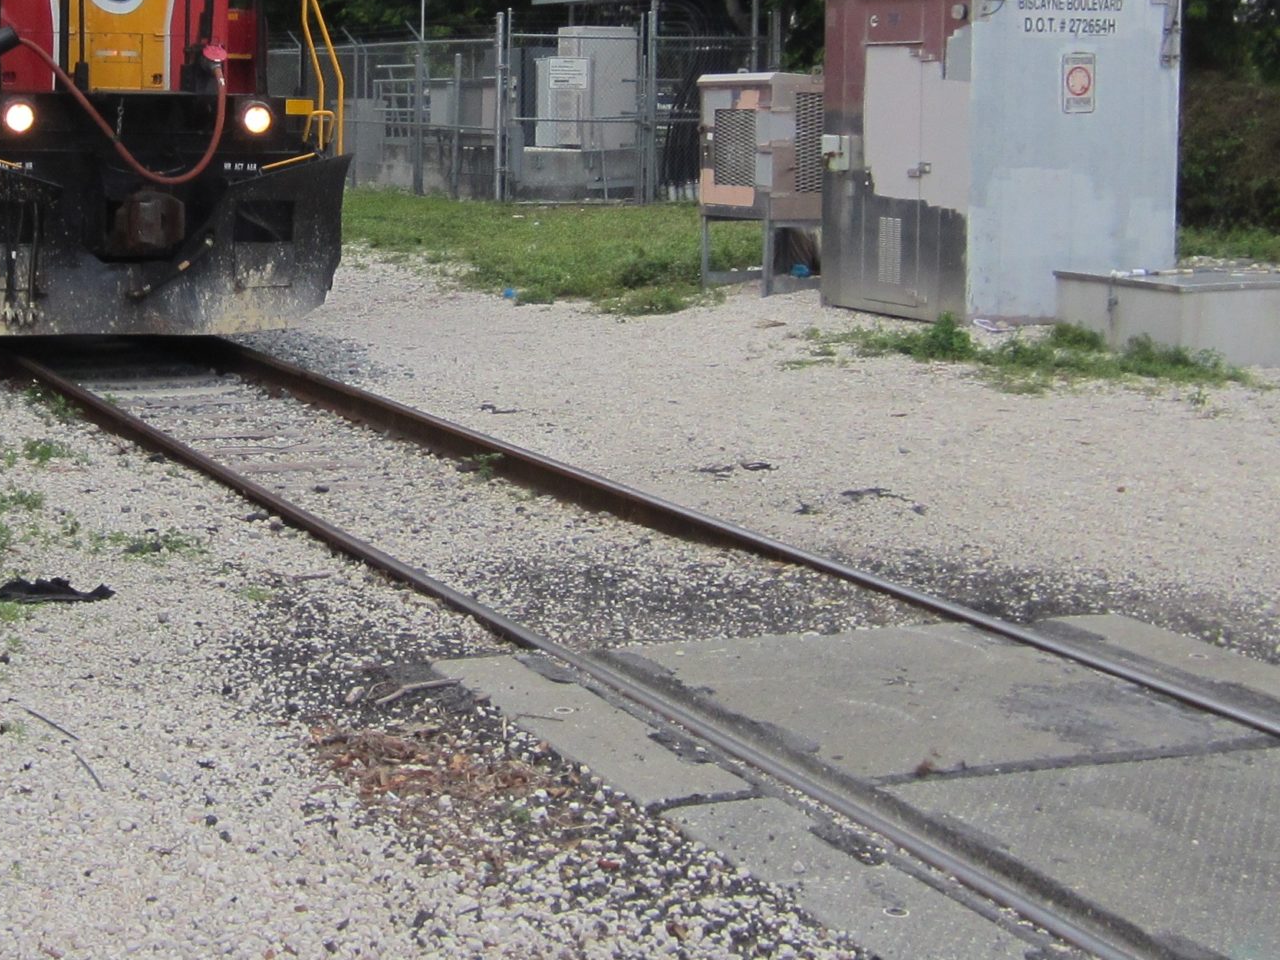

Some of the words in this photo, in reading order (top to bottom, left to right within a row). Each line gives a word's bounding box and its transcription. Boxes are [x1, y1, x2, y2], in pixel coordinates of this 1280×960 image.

[1024, 17, 1057, 33] D.O.T.
[1060, 19, 1066, 32] #
[1069, 18, 1116, 34] 272654H
